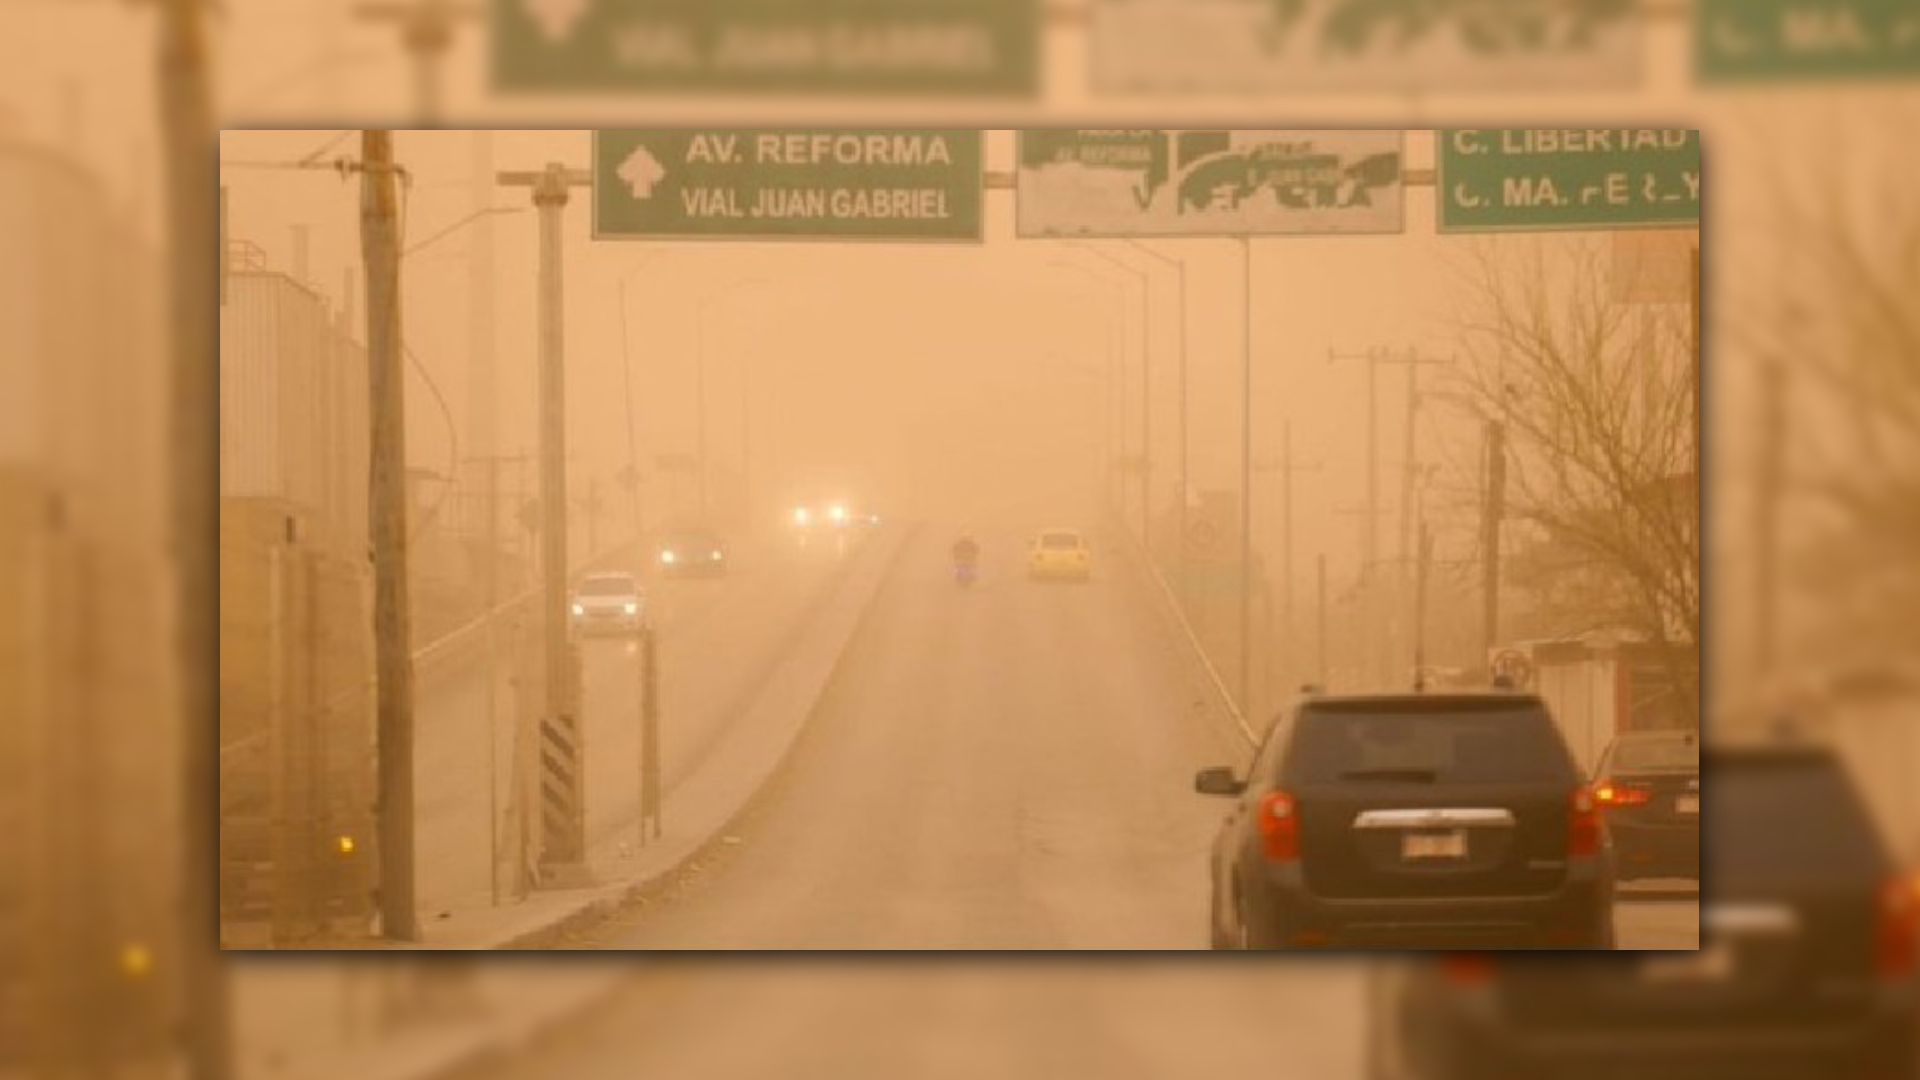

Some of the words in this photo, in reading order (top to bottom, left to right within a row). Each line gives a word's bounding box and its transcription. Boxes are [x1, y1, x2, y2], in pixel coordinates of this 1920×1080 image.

[685, 134, 743, 164] AV.
[757, 134, 951, 165] REFORMA
[681, 188, 744, 218] VIAL
[751, 188, 825, 218] JUAN
[831, 188, 950, 218] GABRIEL
[1503, 177, 1570, 206] MA.
